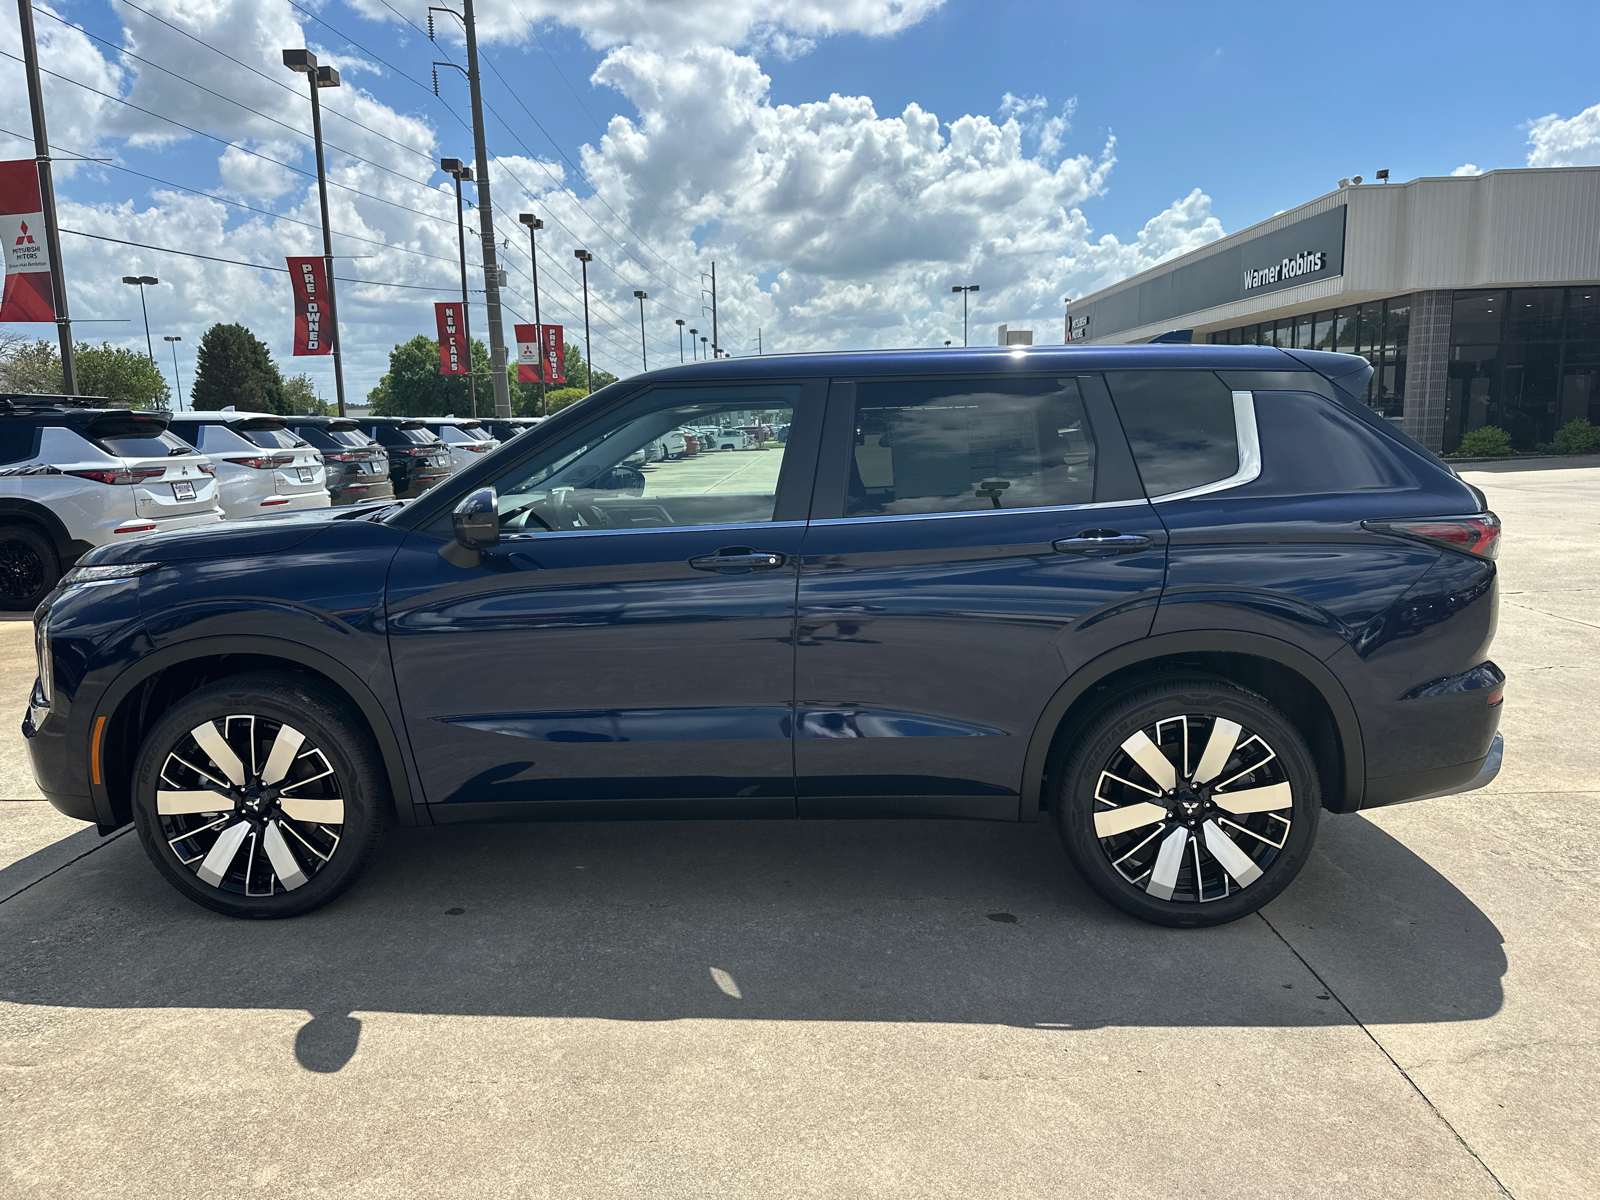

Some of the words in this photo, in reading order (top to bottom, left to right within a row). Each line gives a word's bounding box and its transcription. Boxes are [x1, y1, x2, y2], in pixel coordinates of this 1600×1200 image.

[1243, 264, 1281, 290] Warner
[1281, 250, 1322, 280] Robins
[301, 264, 321, 350] PRE-OWNED
[445, 308, 457, 334] NEW
[449, 337, 458, 371] CARS
[548, 328, 559, 379] PRE-OWNED
